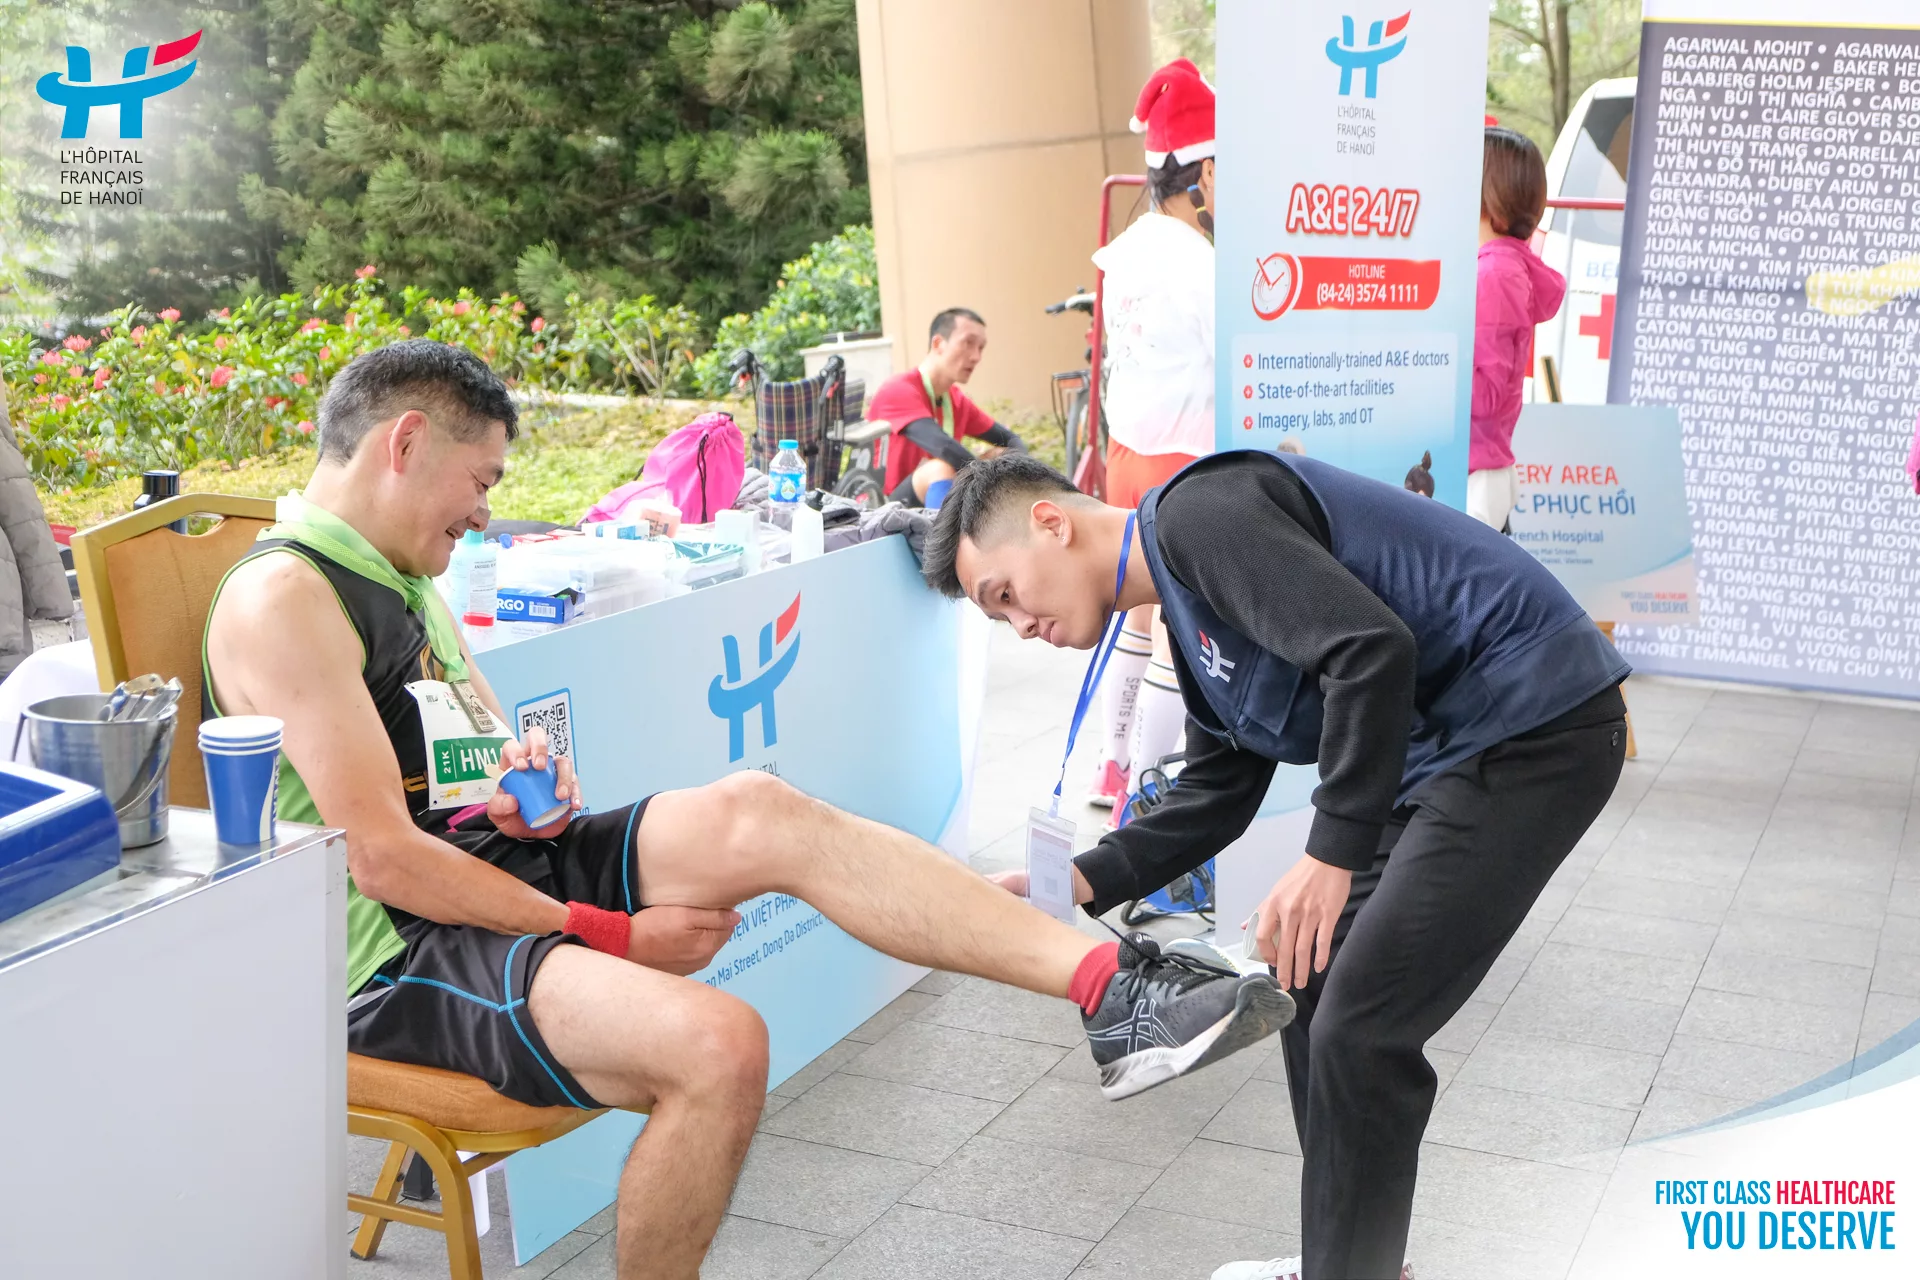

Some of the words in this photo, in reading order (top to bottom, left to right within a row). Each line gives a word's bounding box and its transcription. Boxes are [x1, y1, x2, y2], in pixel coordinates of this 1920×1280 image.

[1664, 37, 1748, 53] AGARWAL
[1754, 39, 1812, 54] MOHIT
[1834, 42, 1920, 58] AGARWAL
[1662, 54, 1737, 70] BAGARIA
[1742, 56, 1805, 72] ANAND
[1833, 59, 1888, 75] BAKER
[1660, 70, 1755, 87] BLAABJERG
[1760, 74, 1812, 89] HOLM
[1818, 76, 1875, 91] JESPER
[1659, 87, 1697, 102] NGA
[1337, 104, 1376, 120] L'HÔPITAL
[1658, 104, 1705, 119] MINH
[1710, 106, 1734, 120] VU
[1761, 108, 1818, 124] CLAIRE
[1824, 110, 1891, 126] GLOVER
[1337, 123, 1375, 140] FRANÇAIS
[1721, 123, 1772, 139] DAJER
[1777, 125, 1858, 142] GREGORY
[1337, 141, 1347, 153] DE
[1349, 141, 1375, 155] HANOÏ
[1748, 141, 1807, 157] TRANG
[1824, 145, 1897, 161] DARRELL
[1848, 163, 1874, 177] DO
[1879, 164, 1907, 178] THI
[1650, 170, 1752, 188] ALEXANDRA
[1768, 176, 1824, 192] DUBEY
[1828, 179, 1878, 194] ARUN
[1287, 184, 1349, 234] A&E
[1352, 186, 1419, 236] 24/7
[1648, 187, 1768, 206] GREVE-ISDAHL
[1792, 193, 1834, 209] FLAA
[1839, 196, 1906, 213] JORGEN
[1844, 213, 1904, 229] TRUNG
[1710, 223, 1760, 239] HUNG
[1765, 226, 1804, 242] NGO
[1828, 229, 1857, 244] IAN
[1644, 237, 1702, 253] JUDIAK
[1708, 240, 1772, 257] MICHAL
[1798, 245, 1858, 261] JUDIAK
[1349, 264, 1386, 280] HOTLINE
[1642, 253, 1734, 271] JUNGHYUN
[1758, 259, 1791, 274] KIM
[1727, 274, 1787, 290] KHANH
[1317, 282, 1354, 306] (84-24)
[1356, 283, 1386, 303] 3574
[1390, 284, 1419, 303] 1111
[1690, 289, 1707, 303] LE
[1712, 290, 1737, 305] NA
[1742, 292, 1780, 307] NGO
[1636, 302, 1663, 317] LEE
[1668, 304, 1775, 324] KWANGSEOK
[1791, 312, 1888, 331] LOHARIKAR
[1635, 318, 1691, 335] CATON
[1696, 322, 1777, 340] ALYWARD
[1782, 328, 1820, 343] ELLA
[1842, 331, 1876, 347] MAI
[1633, 335, 1695, 352] QUANG
[1700, 338, 1747, 355] TUNG
[1258, 351, 1382, 372] Internationally-trained
[1385, 350, 1409, 367] A&E
[1412, 350, 1449, 367] doctors
[1632, 351, 1676, 367] THUY
[1696, 355, 1765, 373] NGUYEN
[1770, 360, 1818, 376] NGOT
[1258, 381, 1347, 399] State-of-the-art
[1350, 379, 1394, 397] facilities
[1758, 375, 1794, 391] BAO
[1798, 378, 1836, 394] ANH
[1767, 392, 1814, 409] MINH
[1258, 411, 1310, 432] Imagery,
[1313, 410, 1336, 428] labs,
[1339, 409, 1356, 425] and
[1360, 407, 1374, 424] OT
[1740, 407, 1812, 425] PHUONG
[1818, 413, 1868, 430] DUNG
[1749, 440, 1806, 458] TRUNG
[1561, 464, 1619, 485] AREA
[1697, 453, 1766, 471] ELSAYED
[1788, 460, 1852, 478] OBBINK
[1704, 469, 1756, 487] JEONG
[1774, 475, 1866, 496] PAVLOVICH
[1533, 494, 1592, 519] PHỤC
[1702, 502, 1777, 521] THULANE
[1510, 530, 1549, 543] rench
[1552, 529, 1604, 544] Hospital
[1704, 518, 1789, 539] ROMBAUT
[1794, 526, 1852, 544] LAURIE
[1728, 536, 1775, 554] LEYLA
[1792, 542, 1838, 559] SHAH
[1844, 546, 1910, 565] MINESH
[1702, 550, 1754, 568] SMITH
[1760, 555, 1825, 574] ESTELLA
[1713, 567, 1805, 589] TOMONARI
[1698, 614, 1746, 632] YOHEI
[1816, 609, 1845, 625] GIA
[1694, 645, 1790, 668] EMMANUEL
[1806, 657, 1838, 673] YEN
[1843, 660, 1879, 677] CHU
[1118, 676, 1140, 718] SPORTS
[1114, 722, 1128, 740] ME
[442, 750, 453, 775] 21K
[751, 900, 772, 928] VIỆT
[717, 963, 733, 985] Mai
[734, 950, 762, 976] Street,
[762, 937, 784, 958] Dong
[784, 929, 795, 946] Da
[796, 913, 824, 938] District,
